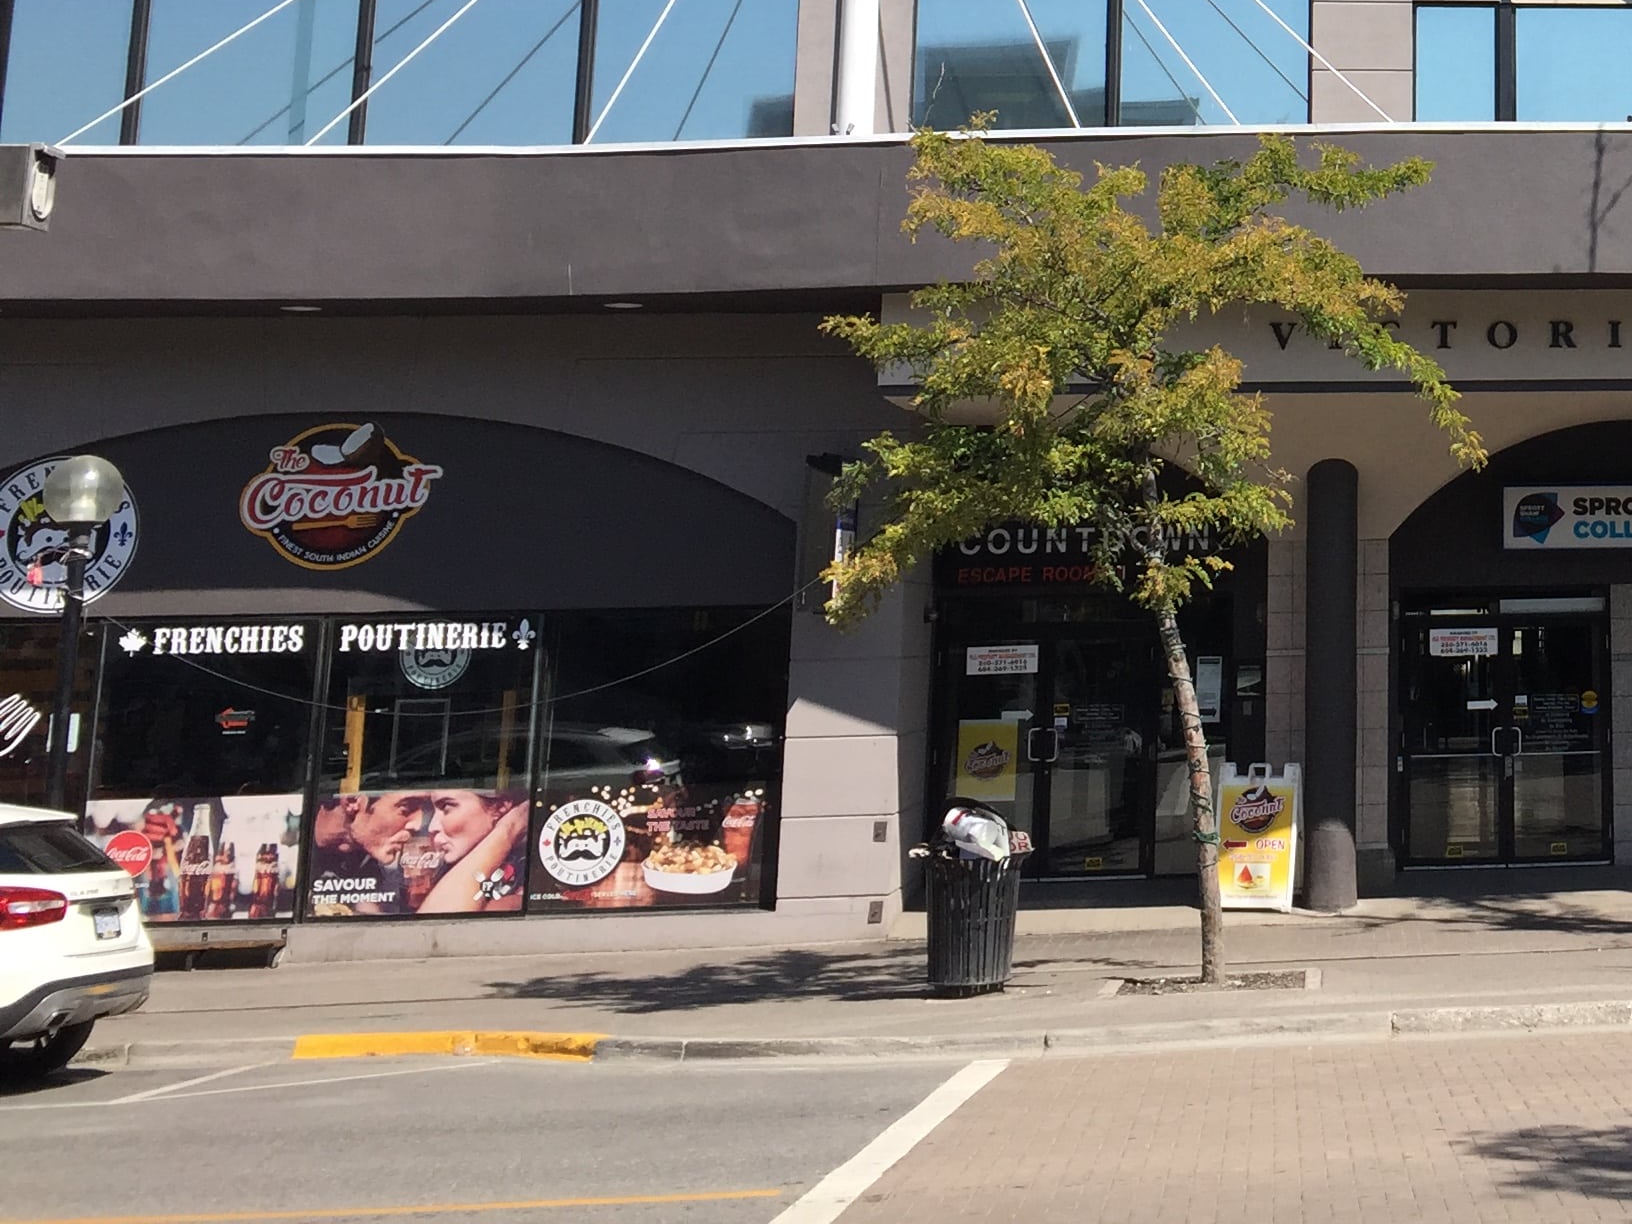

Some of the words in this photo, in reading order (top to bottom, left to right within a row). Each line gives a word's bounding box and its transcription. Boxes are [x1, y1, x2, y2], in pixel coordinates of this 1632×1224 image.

[271, 447, 307, 471] The
[244, 465, 441, 527] Coconut
[957, 567, 1032, 583] ESCAPE
[152, 625, 304, 655] FRENCHIES
[338, 622, 507, 652] POUTINERIE
[1256, 839, 1285, 850] OPEN
[313, 878, 377, 892] SAVOUR
[312, 894, 337, 905] THE
[340, 892, 395, 904] MOMENT
